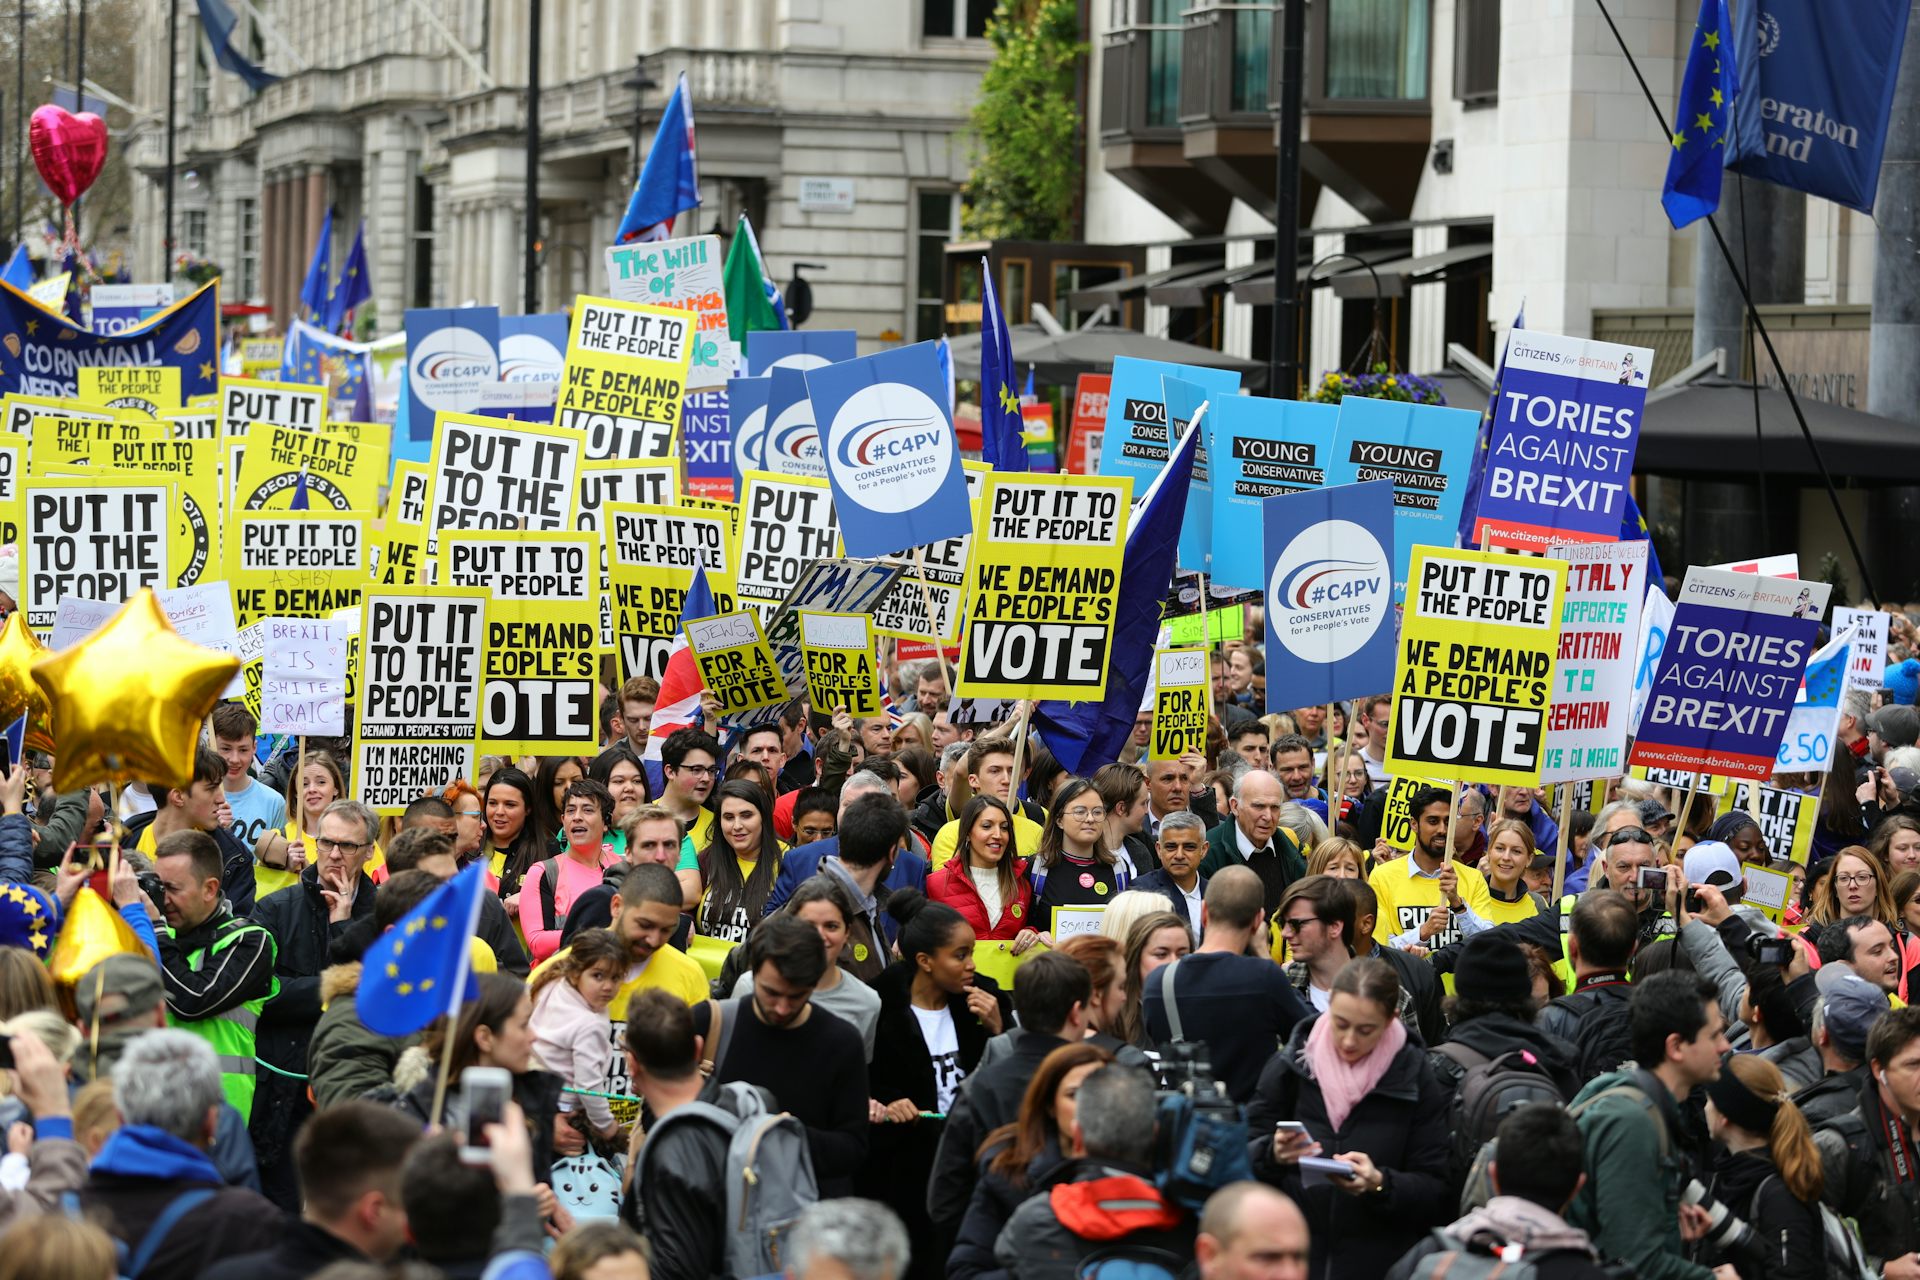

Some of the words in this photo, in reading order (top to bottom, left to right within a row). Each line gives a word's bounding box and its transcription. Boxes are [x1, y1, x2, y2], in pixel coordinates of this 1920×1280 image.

[1760, 97, 1858, 149] eraton
[613, 250, 658, 279] The
[663, 240, 707, 270] Will
[650, 273, 675, 296] of
[584, 309, 625, 333] PUT
[631, 316, 651, 337] IT
[659, 319, 682, 341] TO
[582, 330, 612, 349] THE
[616, 335, 679, 359] PEOPLE
[24, 341, 163, 377] CORNWALL
[441, 364, 491, 379] #C4PV
[1513, 347, 1560, 363] CITIZENS
[1561, 354, 1576, 366] for
[1578, 356, 1618, 371] BRITAIN
[98, 370, 123, 383] PUT
[122, 384, 161, 394] PEOPLE
[569, 366, 595, 387] WE
[601, 371, 680, 400] DEMAND
[228, 391, 280, 420] PUT
[290, 397, 315, 424] IT
[582, 390, 677, 421] PEOPLE'S
[1506, 391, 1634, 440] TORIES
[57, 421, 90, 438] PUT
[113, 443, 145, 461] PUT
[152, 443, 167, 460] IT
[173, 443, 193, 460] TO
[271, 448, 294, 465] THE
[272, 430, 309, 451] PUT
[312, 438, 331, 456] IT
[338, 442, 357, 462] TO
[445, 430, 521, 474] PUT
[532, 441, 569, 480] IT
[873, 430, 940, 461] #C4PV
[1122, 444, 1138, 454] FOR
[1239, 440, 1309, 462] YOUNG
[1358, 444, 1434, 468] YOUNG
[1496, 432, 1628, 472] AGAINST
[854, 455, 936, 482] CONSERVATIVES
[858, 482, 871, 491] for
[880, 472, 915, 486] People's
[917, 466, 937, 478] Vote
[1240, 463, 1326, 483] CONSERVATIVES
[1356, 468, 1448, 489] CONSERVATIVES
[444, 468, 483, 507] TO
[497, 475, 564, 517] THE
[1417, 496, 1440, 507] VOTE
[1489, 467, 1623, 514] BREXIT
[34, 494, 108, 533] PUT
[123, 494, 158, 532] IT
[752, 486, 818, 524] PUT
[994, 488, 1045, 516] PUT
[1053, 490, 1078, 517] IT
[1087, 491, 1116, 519] TO
[244, 524, 289, 547] PUT
[300, 524, 320, 546] IT
[329, 524, 357, 547] TO
[616, 516, 657, 542] PUT
[666, 520, 685, 545] IT
[693, 522, 719, 548] TO
[750, 521, 785, 553] TO
[993, 517, 1030, 538] THE
[1036, 519, 1113, 541] PEOPLE
[34, 536, 76, 571] TO
[89, 535, 158, 570] THE
[244, 549, 278, 566] THE
[286, 549, 356, 566] PEOPLE
[453, 546, 505, 572] PUT
[516, 546, 541, 572] IT
[551, 547, 583, 574] TO
[617, 542, 650, 562] THE
[179, 550, 207, 587] VOTE
[938, 570, 962, 583] VOTE
[979, 564, 1010, 590] WE
[1018, 566, 1115, 594] DEMAND
[501, 575, 583, 596] PEOPLE
[737, 584, 773, 598] DEMAND
[1312, 577, 1381, 604] #C4PV
[1423, 562, 1476, 592] PUT
[1483, 569, 1510, 597] IT
[1519, 572, 1549, 601] TO
[1688, 583, 1736, 598] CITIZENS
[1736, 590, 1751, 600] for
[1753, 591, 1793, 605] BRITAIN
[237, 589, 265, 610] WE
[275, 589, 361, 611] DEMAND
[616, 584, 642, 608] WE
[973, 594, 987, 618] A
[996, 594, 1112, 621] PEOPLE'S
[1421, 591, 1460, 615] THE
[1466, 596, 1547, 625] PEOPLE
[372, 602, 435, 643] PUT
[446, 605, 477, 643] IT
[1289, 604, 1371, 625] CONSERVATIVES
[1562, 602, 1628, 623] UPPORTS
[273, 624, 331, 641] BREXIT
[489, 622, 593, 649] DEMAND
[695, 618, 749, 642] JEWS
[1291, 627, 1302, 635] for
[1313, 620, 1348, 632] People's
[1349, 616, 1369, 626] Vote
[973, 623, 1105, 681] VOTE
[1407, 639, 1440, 667] WE
[1448, 643, 1550, 679] DEMAND
[1676, 625, 1805, 668] TORIES
[1858, 643, 1878, 654] THE
[288, 650, 315, 670] IS
[371, 645, 405, 682] TO
[417, 646, 474, 682] THE
[700, 651, 746, 676] FOR
[807, 651, 847, 674] FOR
[1164, 656, 1204, 674] OXFORD
[267, 682, 328, 695] SHITE
[706, 666, 772, 690] PEOPLE'S
[810, 672, 871, 688] PEOPLE'S
[1425, 670, 1547, 706] PEOPLE'S
[1564, 669, 1595, 692] TO
[1660, 663, 1795, 699] AGAINST
[368, 684, 471, 718] PEOPLE
[714, 678, 782, 710] VOTE
[808, 687, 874, 714] VOTE
[1158, 691, 1192, 714] FOR
[273, 701, 329, 723] CRAIC
[1157, 713, 1204, 728] PEOPLE'S
[1548, 701, 1609, 731] REMAIN
[1650, 694, 1785, 737] BREXIT
[361, 725, 396, 737] DEMAND
[406, 725, 449, 737] PEOPLE'S
[451, 725, 475, 737] VOTE
[1156, 728, 1204, 755] VOTE
[1401, 698, 1540, 767] VOTE
[389, 747, 465, 765] MARCHING
[1586, 748, 1619, 768] MAIO
[1797, 734, 1828, 762] 50
[1637, 749, 1766, 774] www.citizens4britain.org
[366, 767, 383, 786] TO
[389, 767, 449, 786] DEMAND
[364, 788, 424, 805] PEOPLES
[1778, 793, 1800, 818] IT
[1760, 813, 1795, 840] THE
[1060, 920, 1100, 935] SOMER
[1587, 974, 1615, 984] Canon
